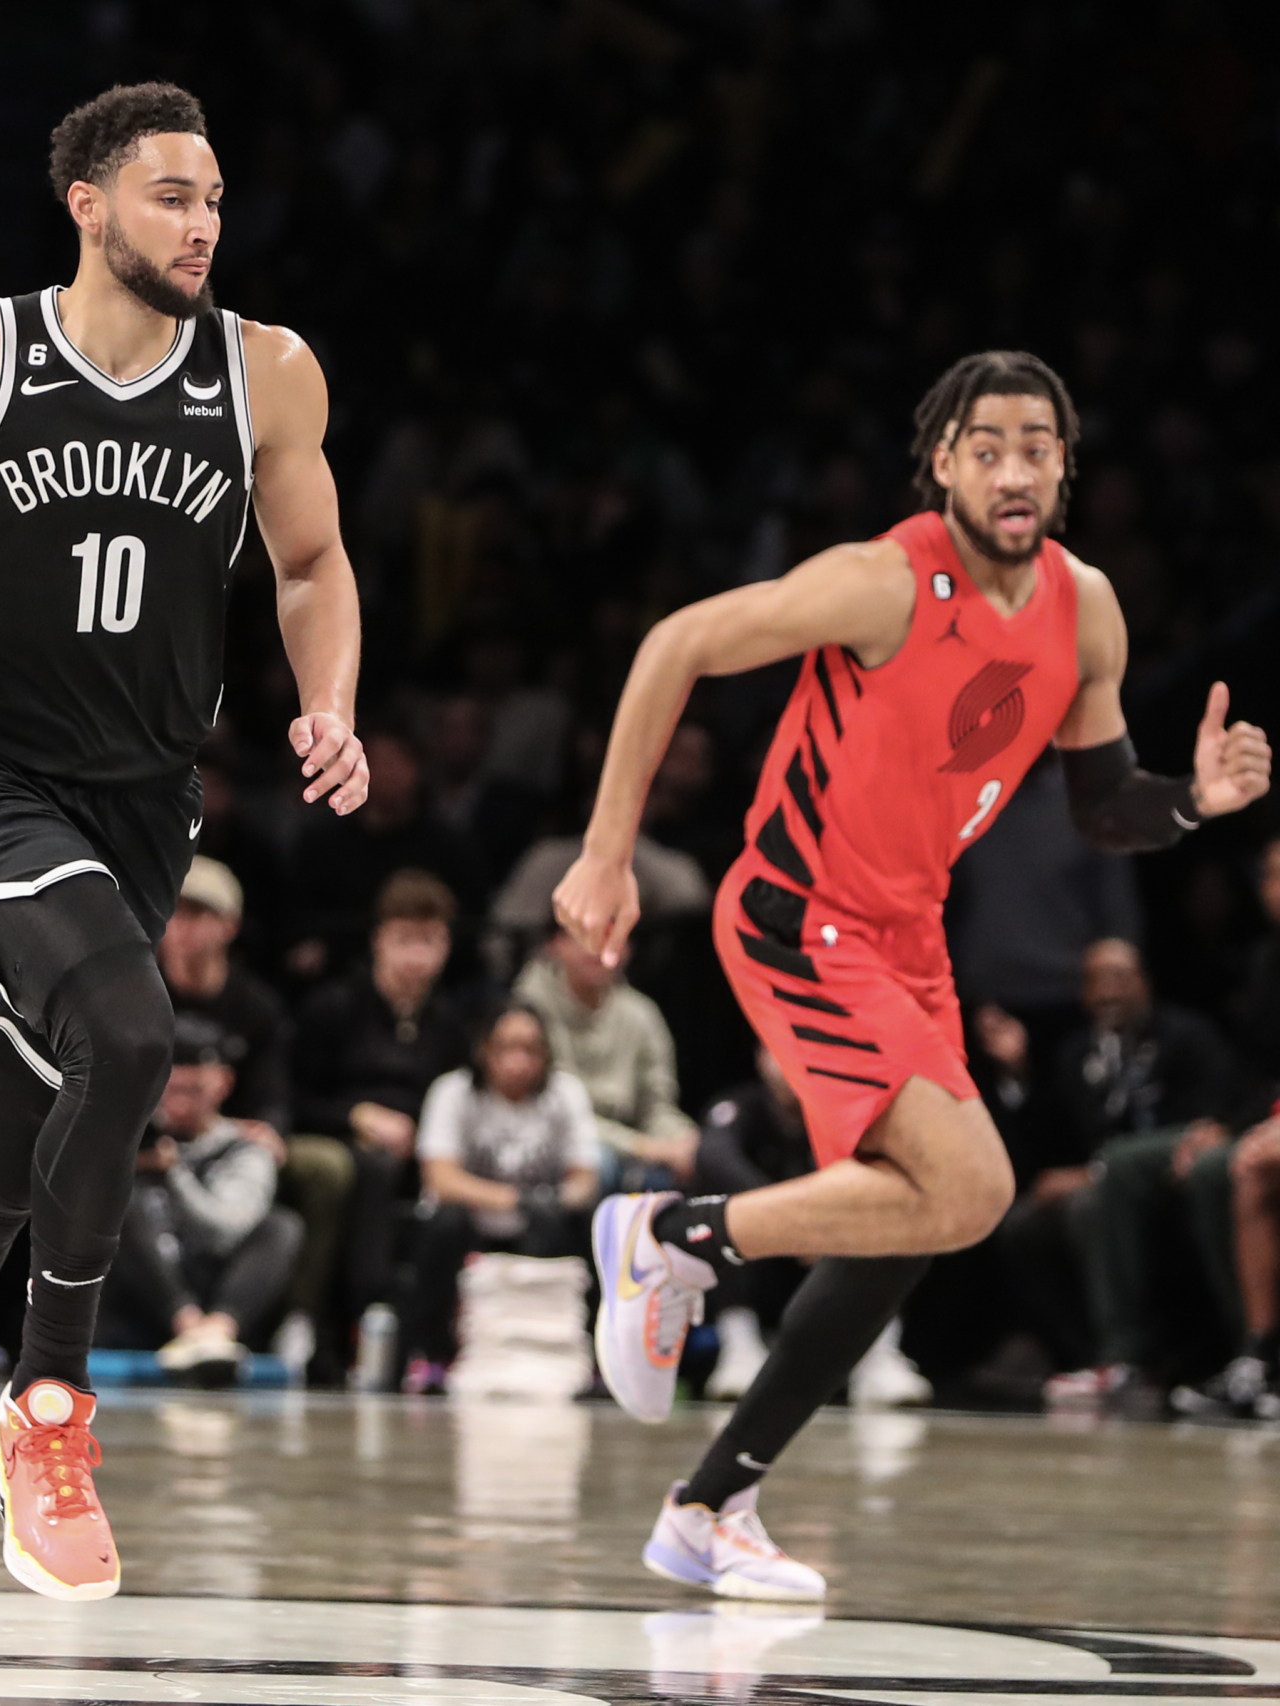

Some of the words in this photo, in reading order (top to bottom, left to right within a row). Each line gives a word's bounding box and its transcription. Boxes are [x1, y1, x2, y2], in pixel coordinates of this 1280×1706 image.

[27, 343, 48, 366] 6
[183, 404, 222, 417] Webull
[72, 532, 146, 633] 10
[932, 573, 952, 600] 6
[959, 779, 1002, 840] 2
